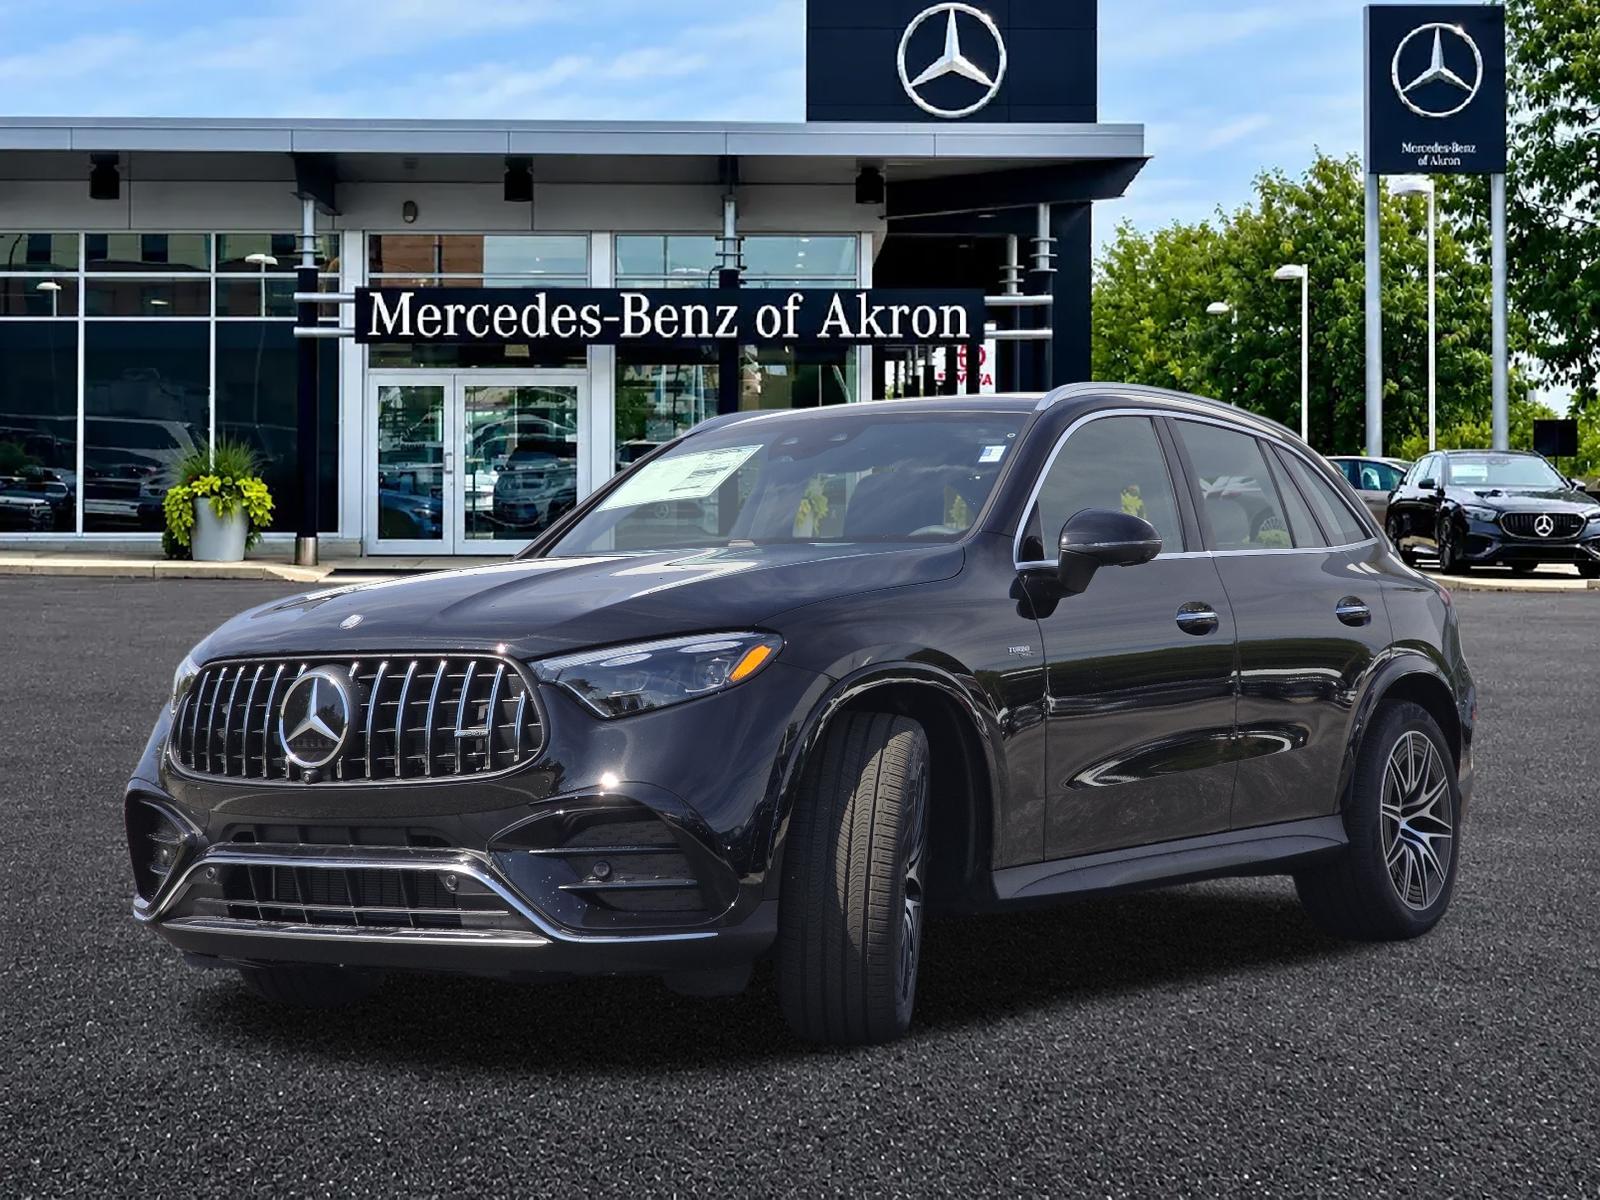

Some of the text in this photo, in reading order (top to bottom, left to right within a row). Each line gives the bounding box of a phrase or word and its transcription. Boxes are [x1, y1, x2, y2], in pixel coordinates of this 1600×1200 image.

[1401, 142, 1477, 154] Mercedes-Benz
[1417, 154, 1461, 166] of Akron
[367, 291, 970, 340] Mercedes-Benz of Akron
